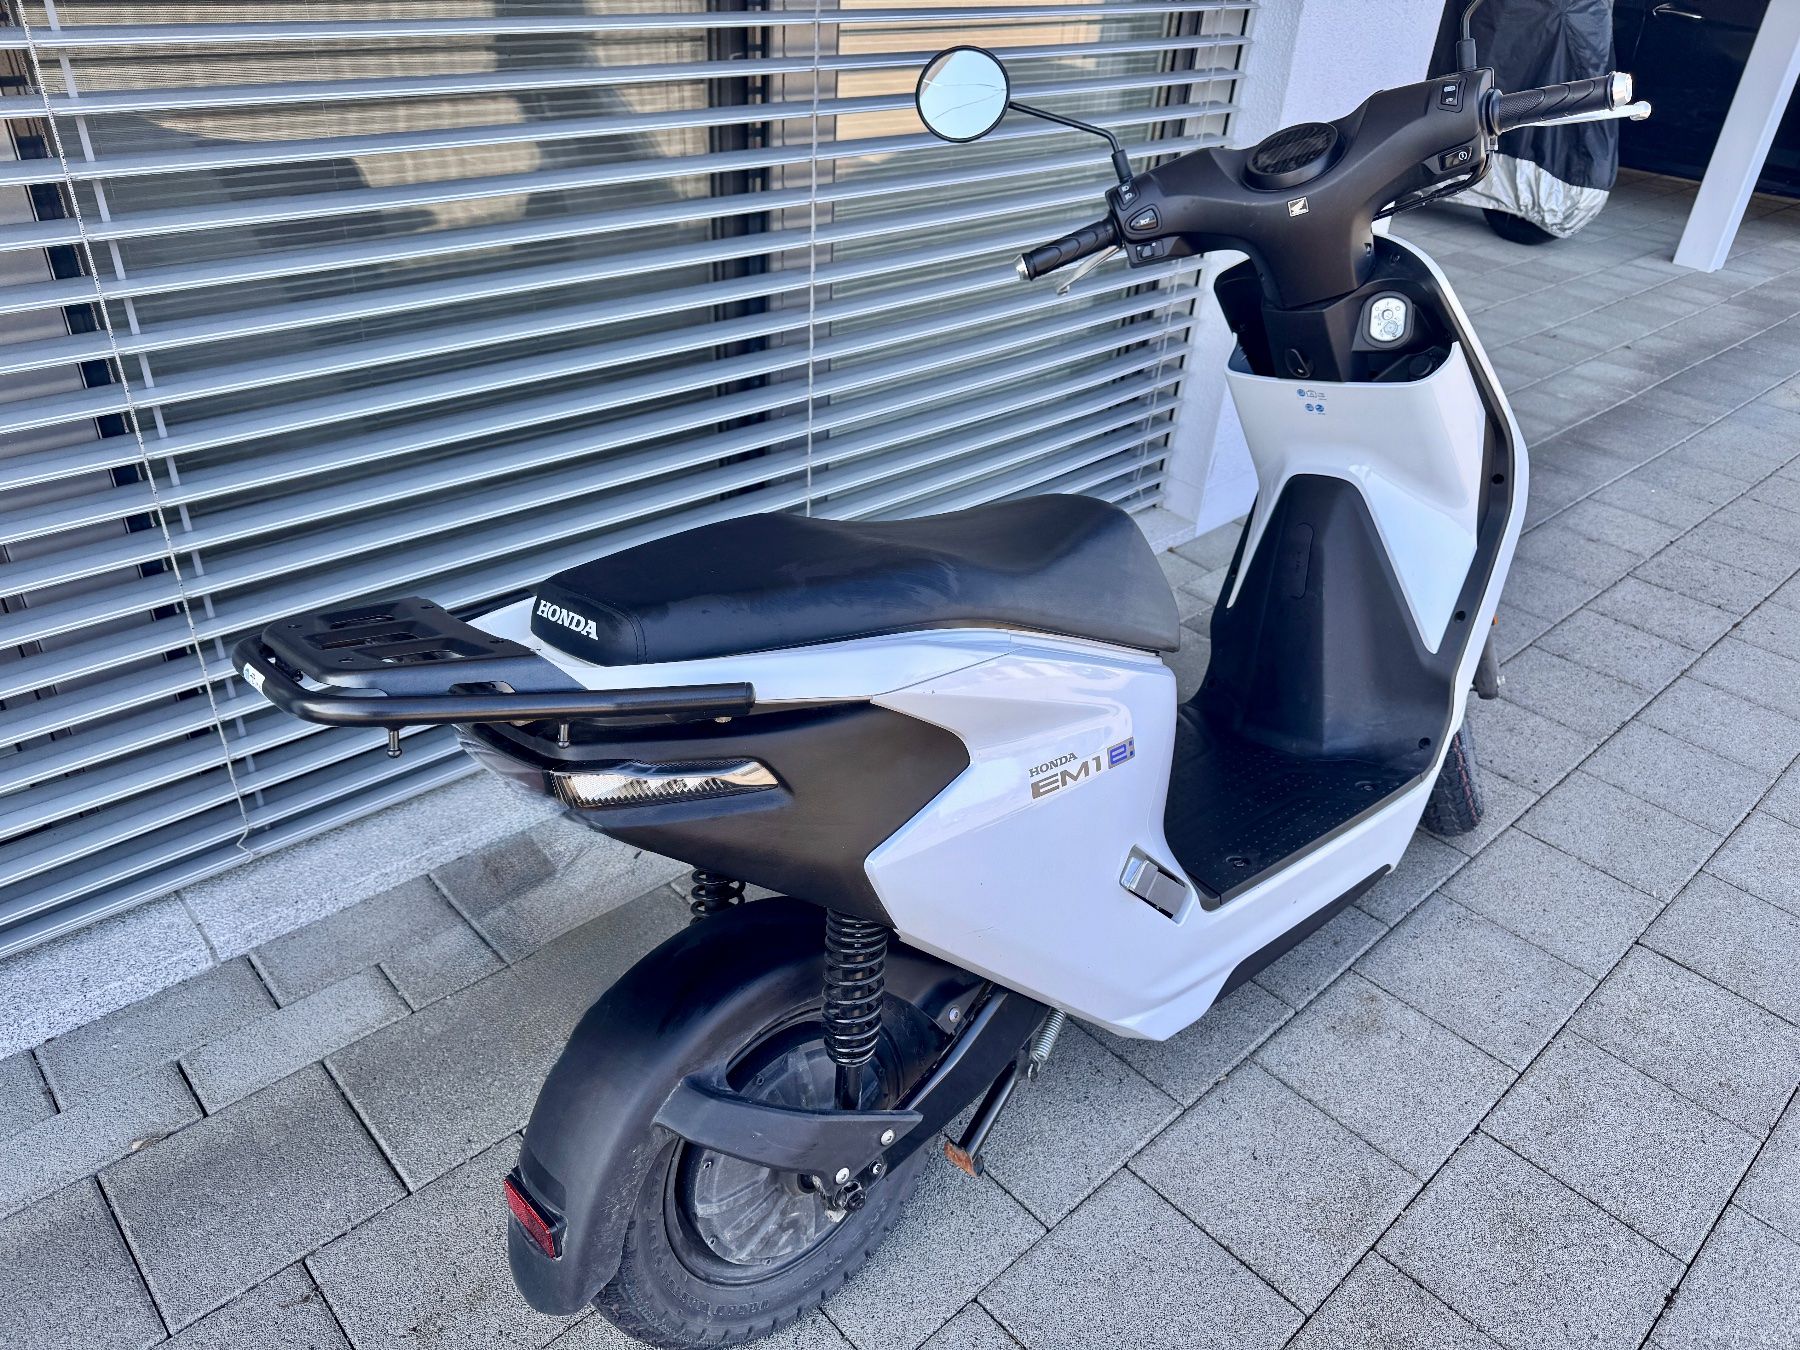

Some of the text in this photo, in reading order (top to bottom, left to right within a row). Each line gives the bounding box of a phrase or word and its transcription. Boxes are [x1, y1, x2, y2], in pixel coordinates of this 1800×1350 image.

[537, 600, 598, 640] HONDA
[1028, 752, 1078, 777] HONDA
[1031, 755, 1102, 799] EM1
